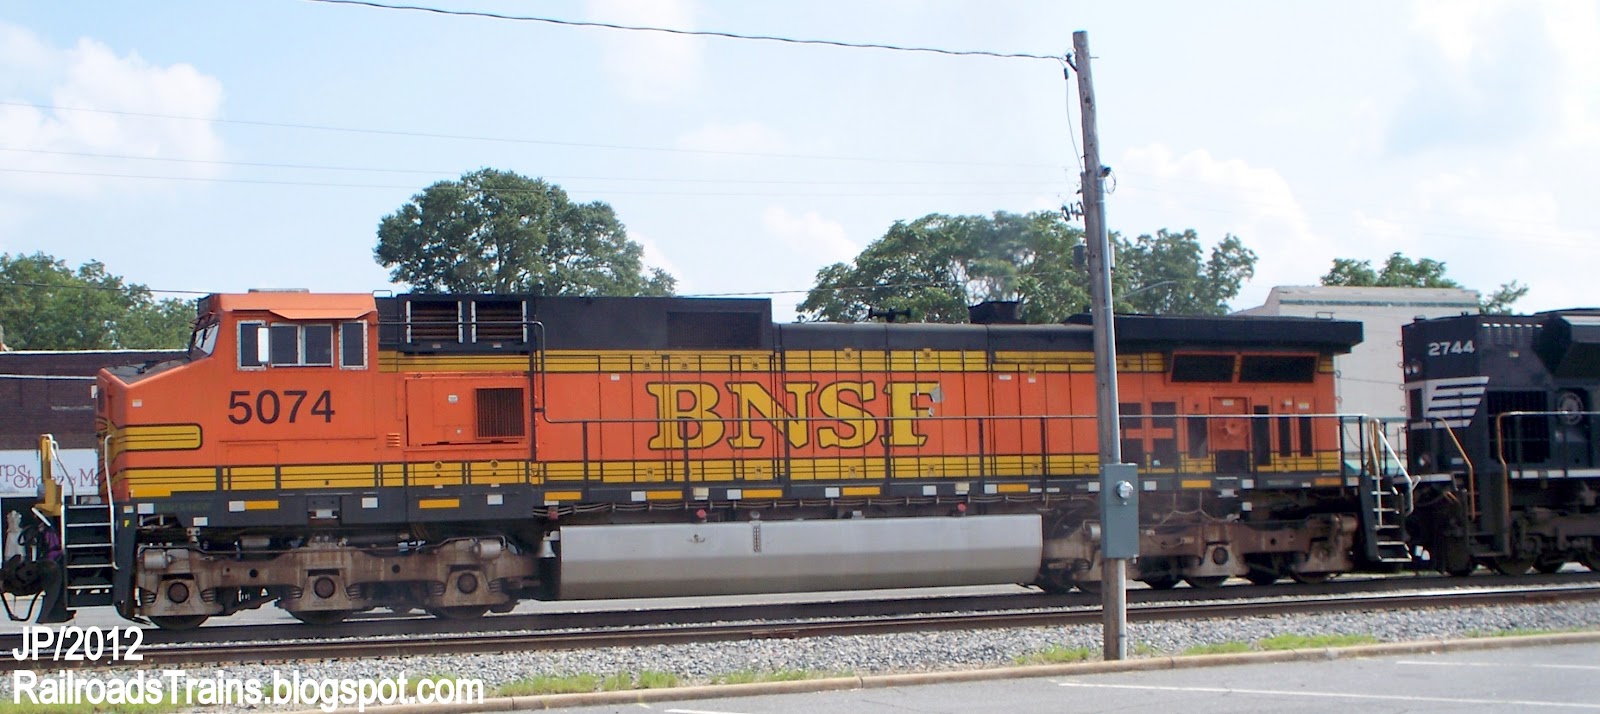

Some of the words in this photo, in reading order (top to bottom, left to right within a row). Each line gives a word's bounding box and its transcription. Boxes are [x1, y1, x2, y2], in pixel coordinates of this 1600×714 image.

[1428, 340, 1475, 356] 2744
[228, 389, 336, 425] 5074
[646, 380, 939, 450] BNSF
